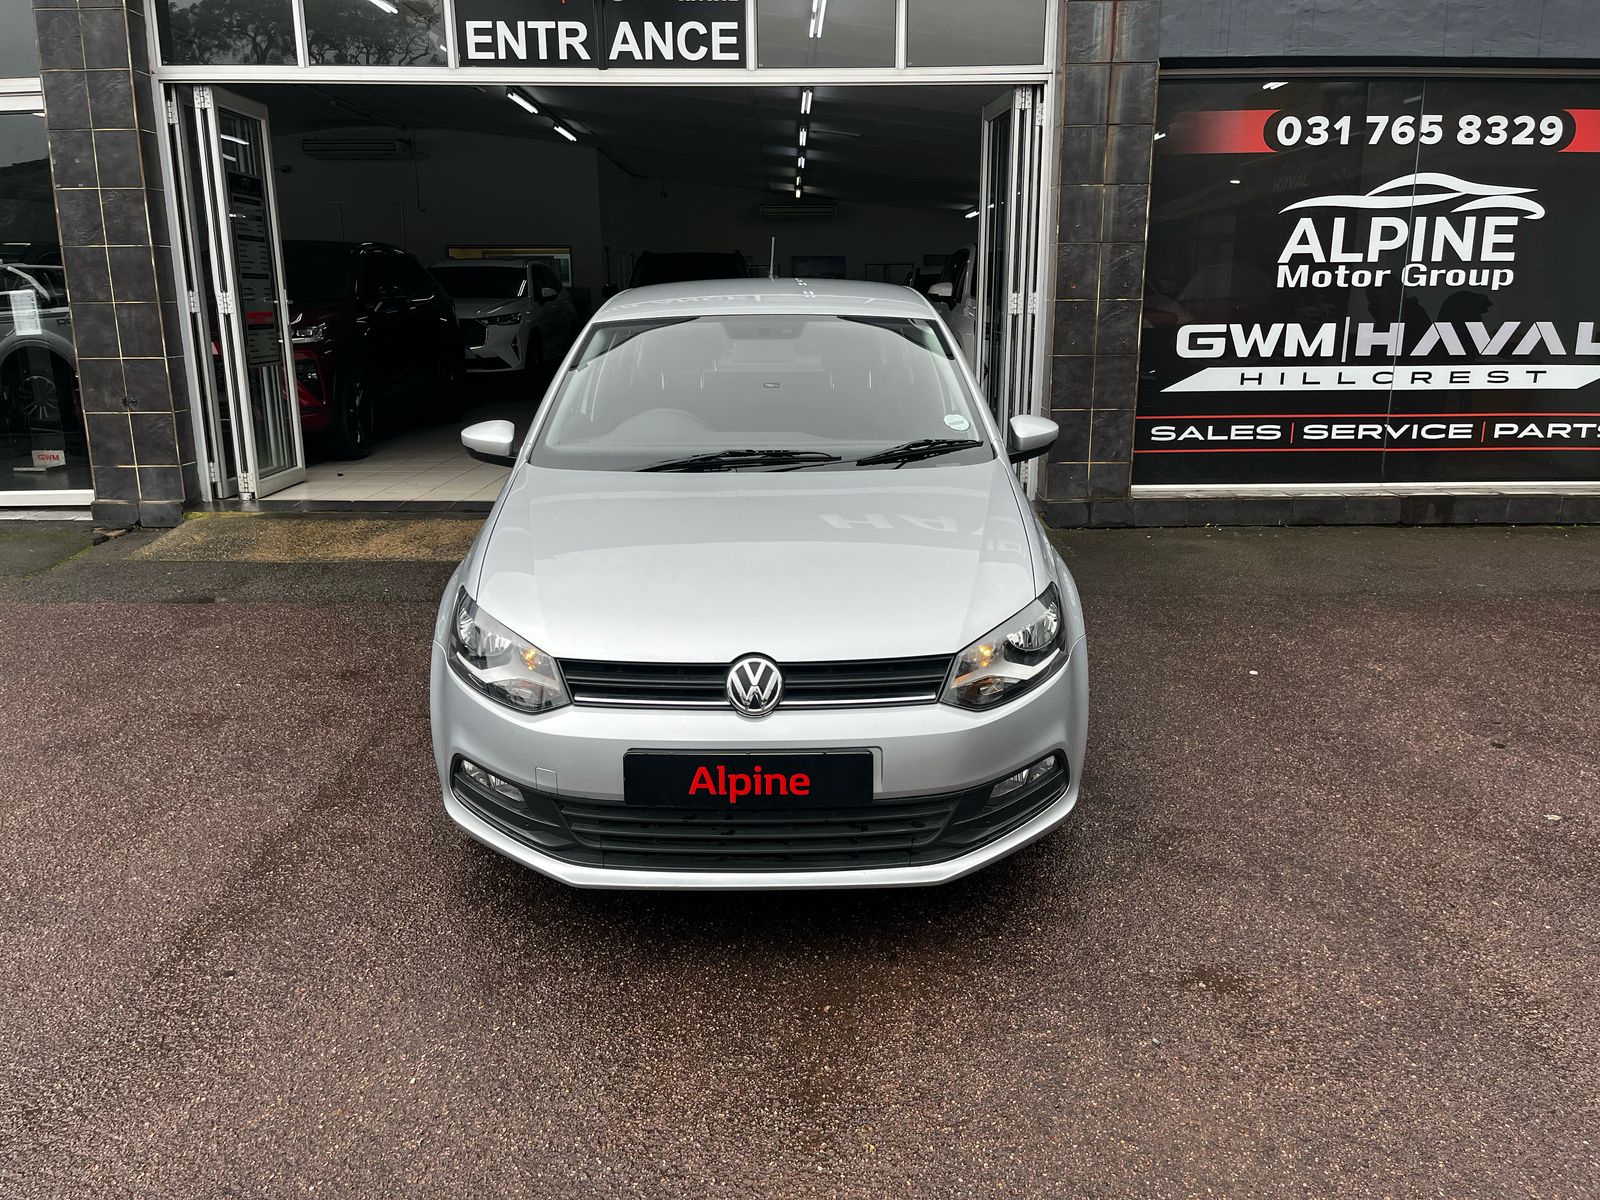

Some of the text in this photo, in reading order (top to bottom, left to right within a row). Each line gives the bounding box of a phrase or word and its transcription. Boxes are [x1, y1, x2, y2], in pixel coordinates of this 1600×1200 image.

[1276, 114, 1564, 147] 031 765 8329
[1277, 216, 1519, 264] ALPINE
[1276, 263, 1515, 291] Motor Group
[1175, 321, 1600, 359] GWM HAVAL
[1239, 369, 1548, 387] HILLCREST
[1150, 422, 1600, 442] SALES SERVICE PART
[688, 765, 811, 804] Alpine
